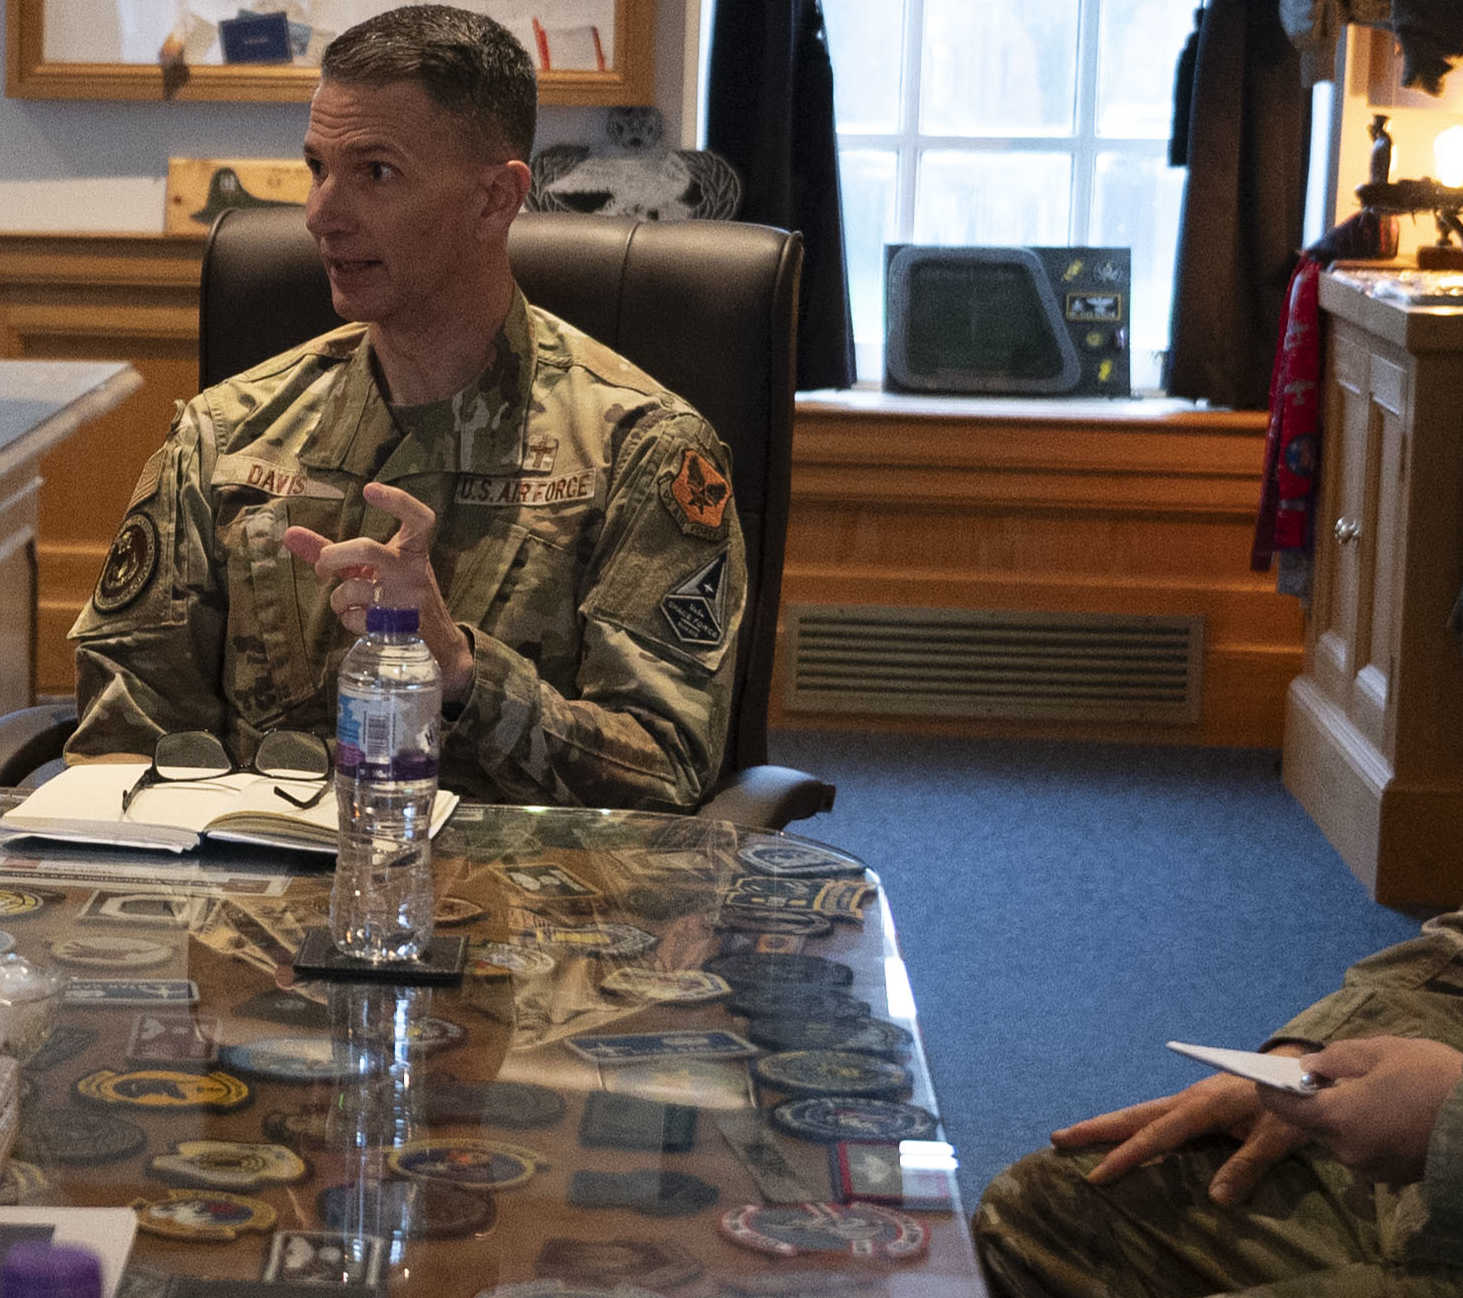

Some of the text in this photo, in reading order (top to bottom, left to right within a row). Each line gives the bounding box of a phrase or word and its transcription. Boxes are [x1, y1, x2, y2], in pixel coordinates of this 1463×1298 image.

[248, 464, 307, 495] DAVIS
[461, 473, 590, 501] U.S. AIR FORCE
